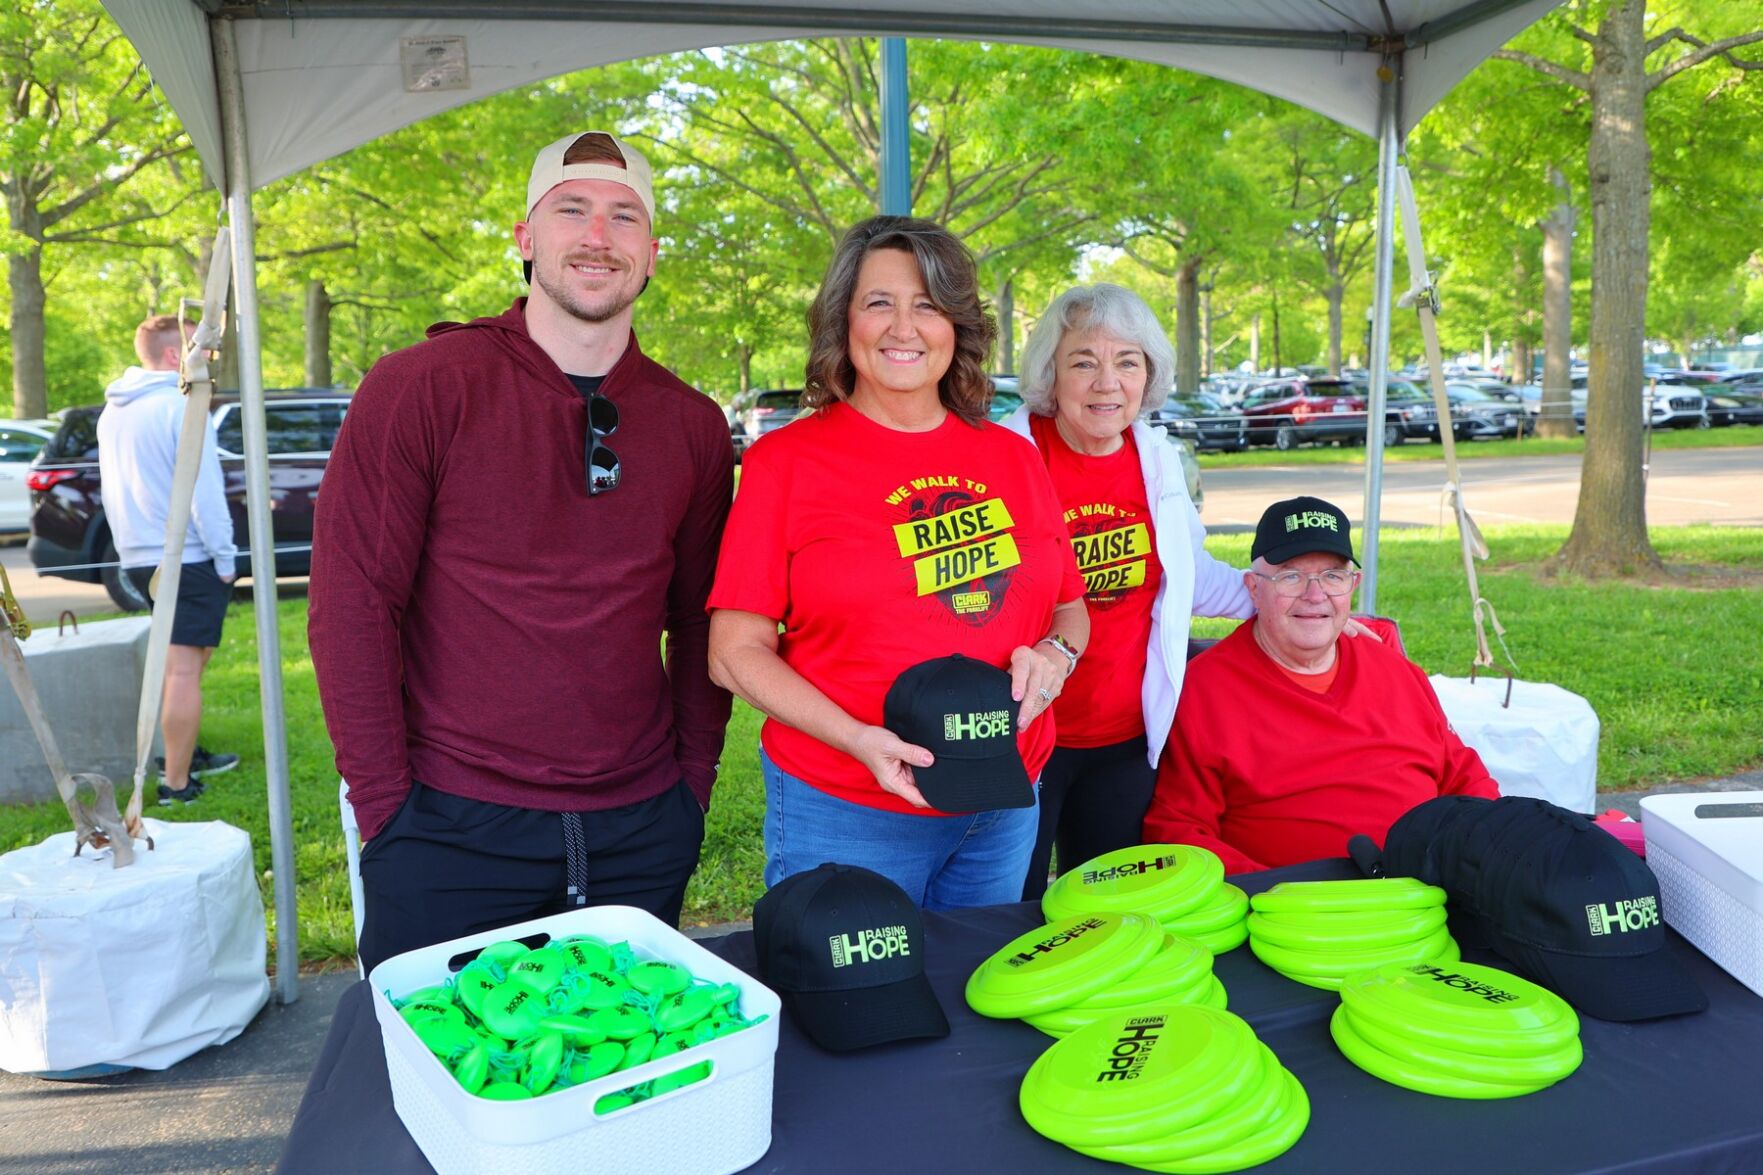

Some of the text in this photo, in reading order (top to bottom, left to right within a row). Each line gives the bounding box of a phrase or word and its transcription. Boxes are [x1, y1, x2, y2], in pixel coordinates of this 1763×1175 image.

[884, 476, 987, 506] WE WALK TO
[1079, 503, 1115, 516] WALK
[1292, 511, 1338, 532] HOPE
[913, 504, 994, 550] RAISE
[1074, 528, 1136, 567] RAISE
[935, 542, 999, 587] HOPE
[955, 593, 987, 606] CLARK
[955, 713, 1010, 740] HOPE
[976, 710, 1009, 721] RAISING
[1083, 857, 1163, 880] HOPE
[1623, 896, 1656, 911] RAISING
[1599, 902, 1659, 934] HOPE
[865, 926, 906, 940] RAISING
[1017, 919, 1107, 961] HOPE
[832, 938, 844, 964] CLARK
[841, 931, 910, 965] HOPE
[1416, 967, 1508, 1004] HOPE
[1130, 1014, 1164, 1025] CLARK
[1097, 1023, 1165, 1082] HOPE
[1127, 1041, 1156, 1079] RAISING
